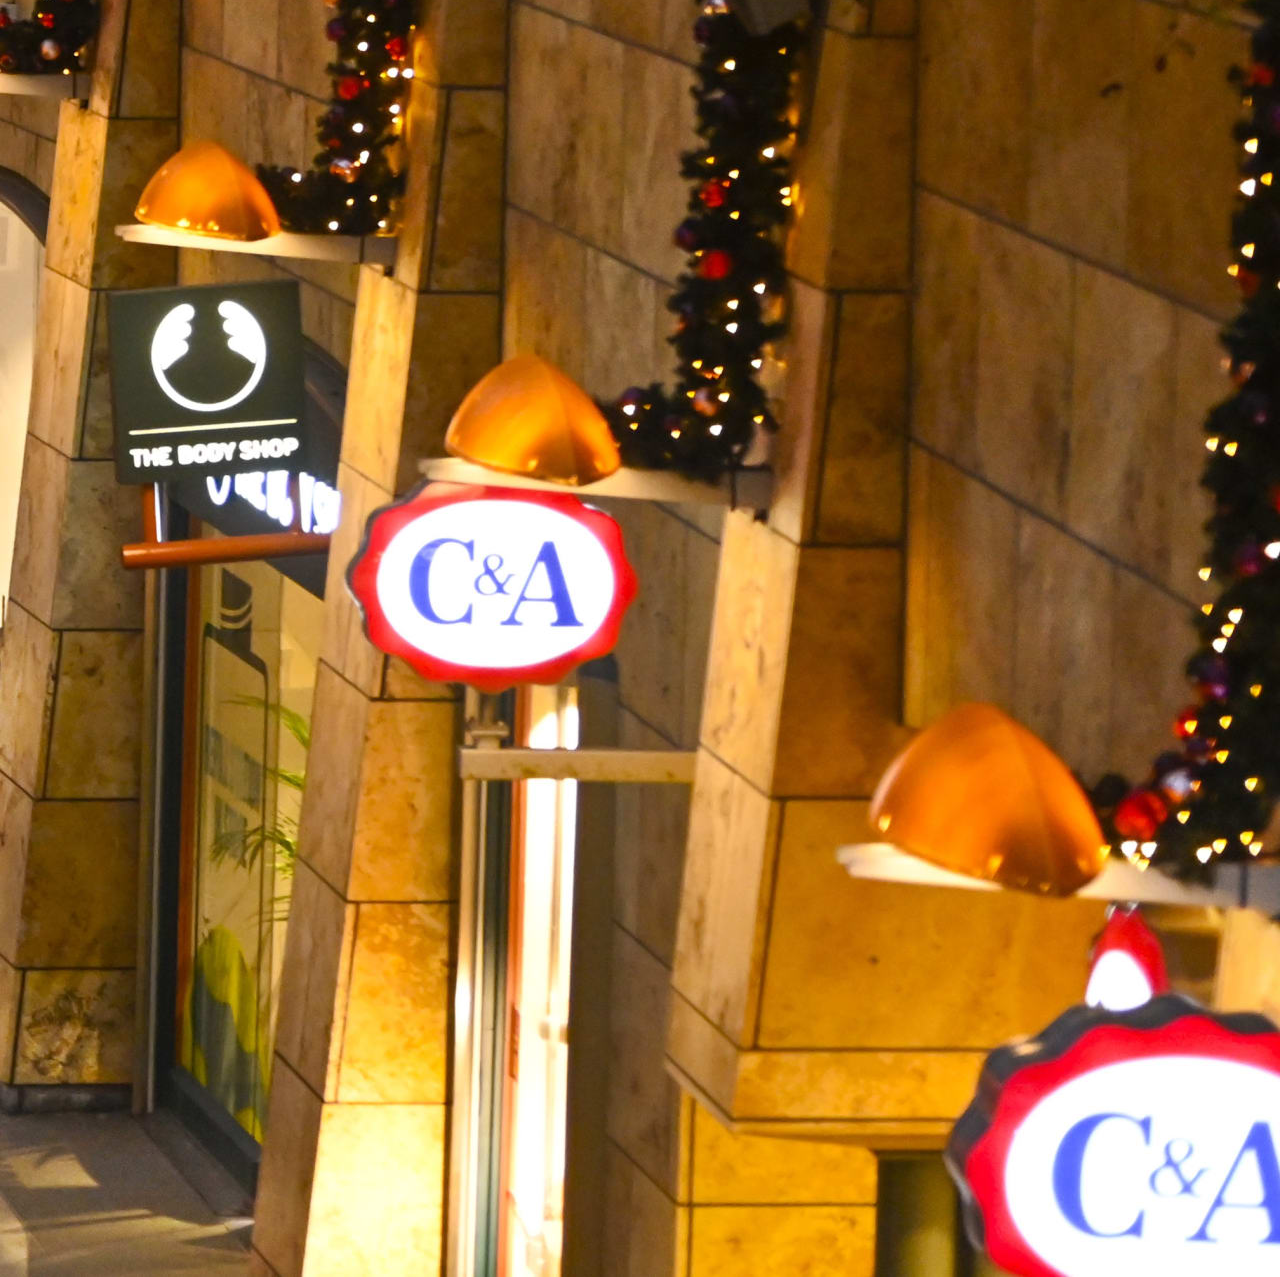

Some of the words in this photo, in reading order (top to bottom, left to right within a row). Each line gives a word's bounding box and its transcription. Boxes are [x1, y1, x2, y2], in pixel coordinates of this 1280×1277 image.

[129, 445, 173, 468] THE
[177, 441, 237, 465] BODY
[238, 437, 300, 461] SHOP
[408, 537, 585, 627] C&A
[1051, 1110, 1280, 1245] C&A
